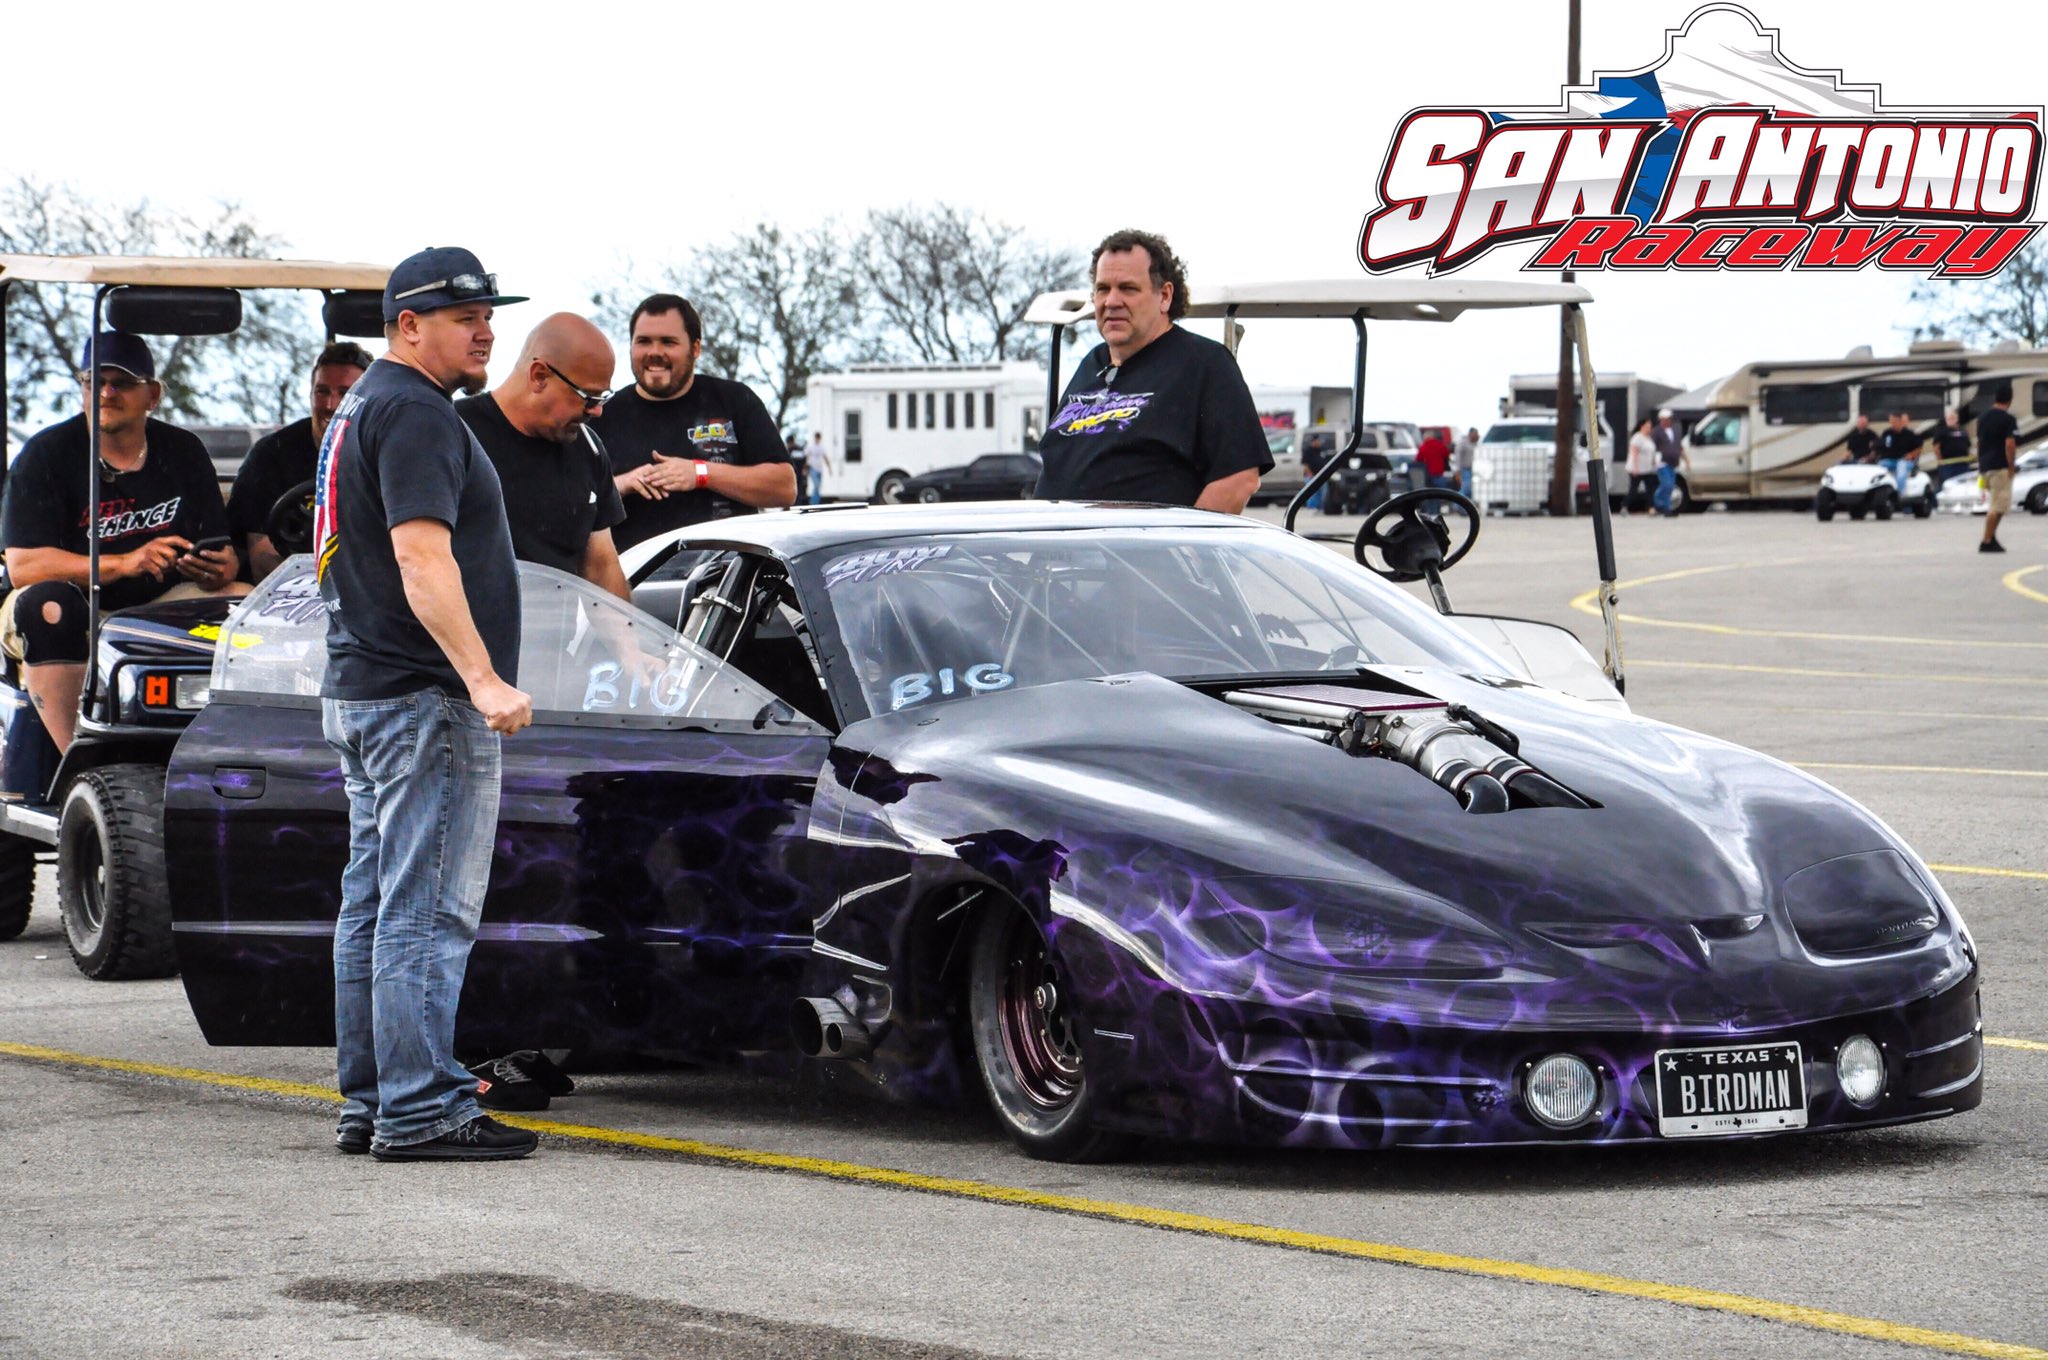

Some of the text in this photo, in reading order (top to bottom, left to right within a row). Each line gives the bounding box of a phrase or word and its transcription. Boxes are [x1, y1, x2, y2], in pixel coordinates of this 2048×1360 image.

[583, 661, 690, 713] BIG
[890, 663, 1014, 711] BIG
[1701, 1050, 1770, 1065] TEXAS
[1680, 1069, 1791, 1114] BIRDMAN
